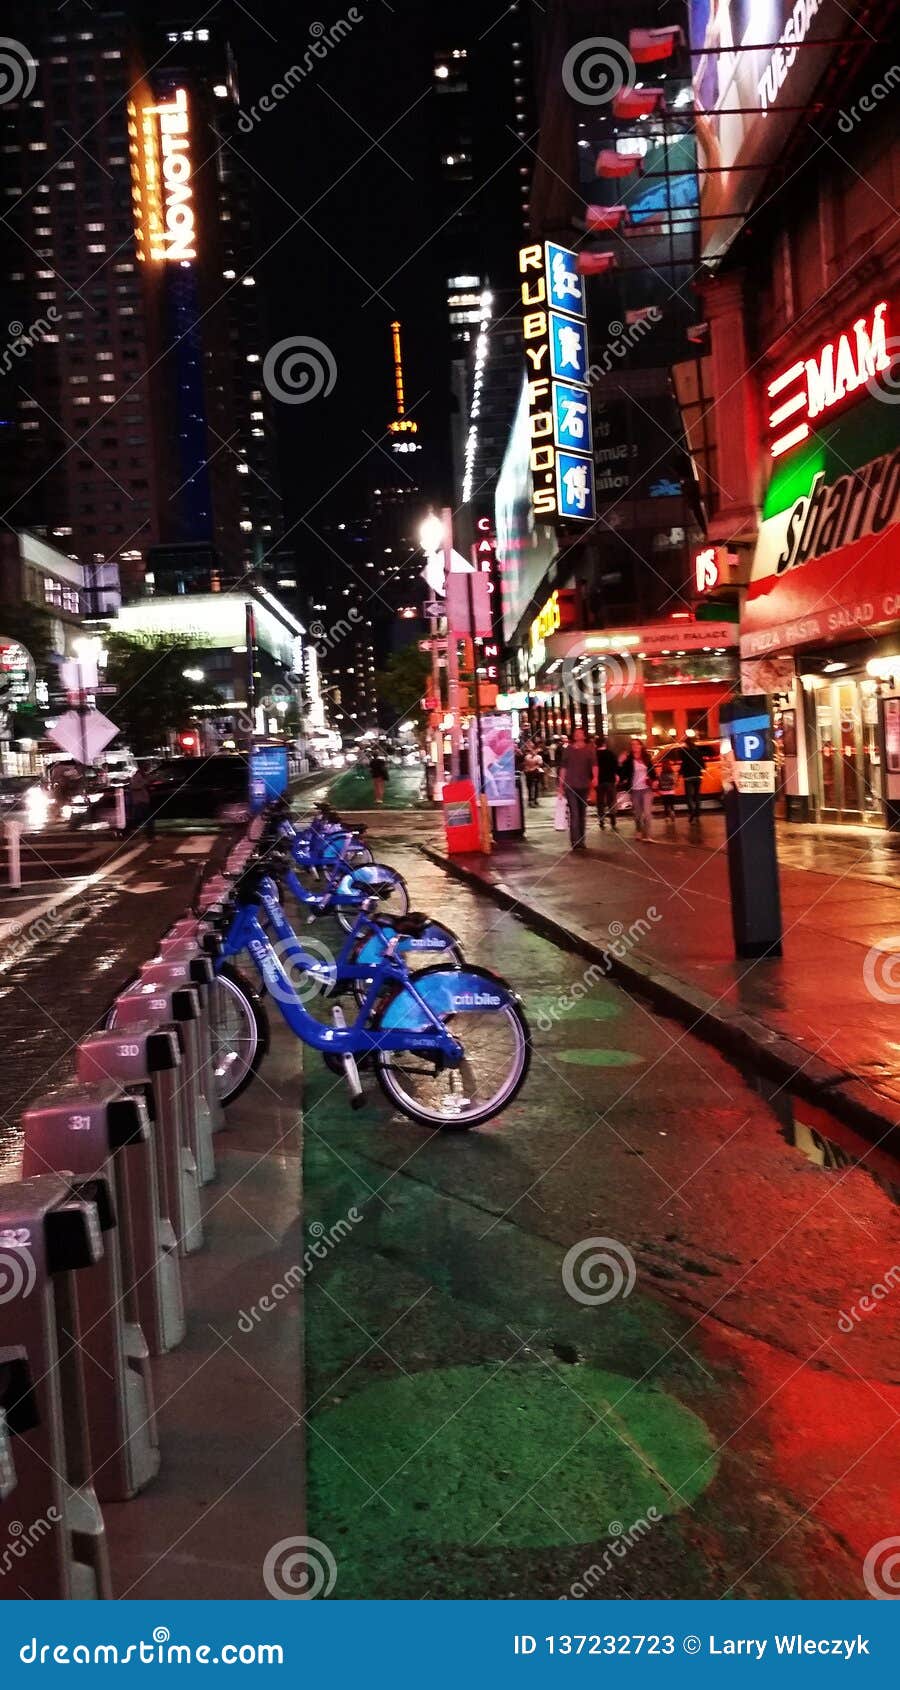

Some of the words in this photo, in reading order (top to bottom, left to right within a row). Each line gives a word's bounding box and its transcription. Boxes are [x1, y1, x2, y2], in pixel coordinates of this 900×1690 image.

[758, 0, 823, 117] TUESDA
[149, 88, 197, 260] NOVOTEL
[828, 603, 874, 631] SALAD
[743, 735, 760, 759] P
[474, 993, 501, 1006] bike
[119, 1045, 139, 1056] 30
[68, 1116, 91, 1130] 31
